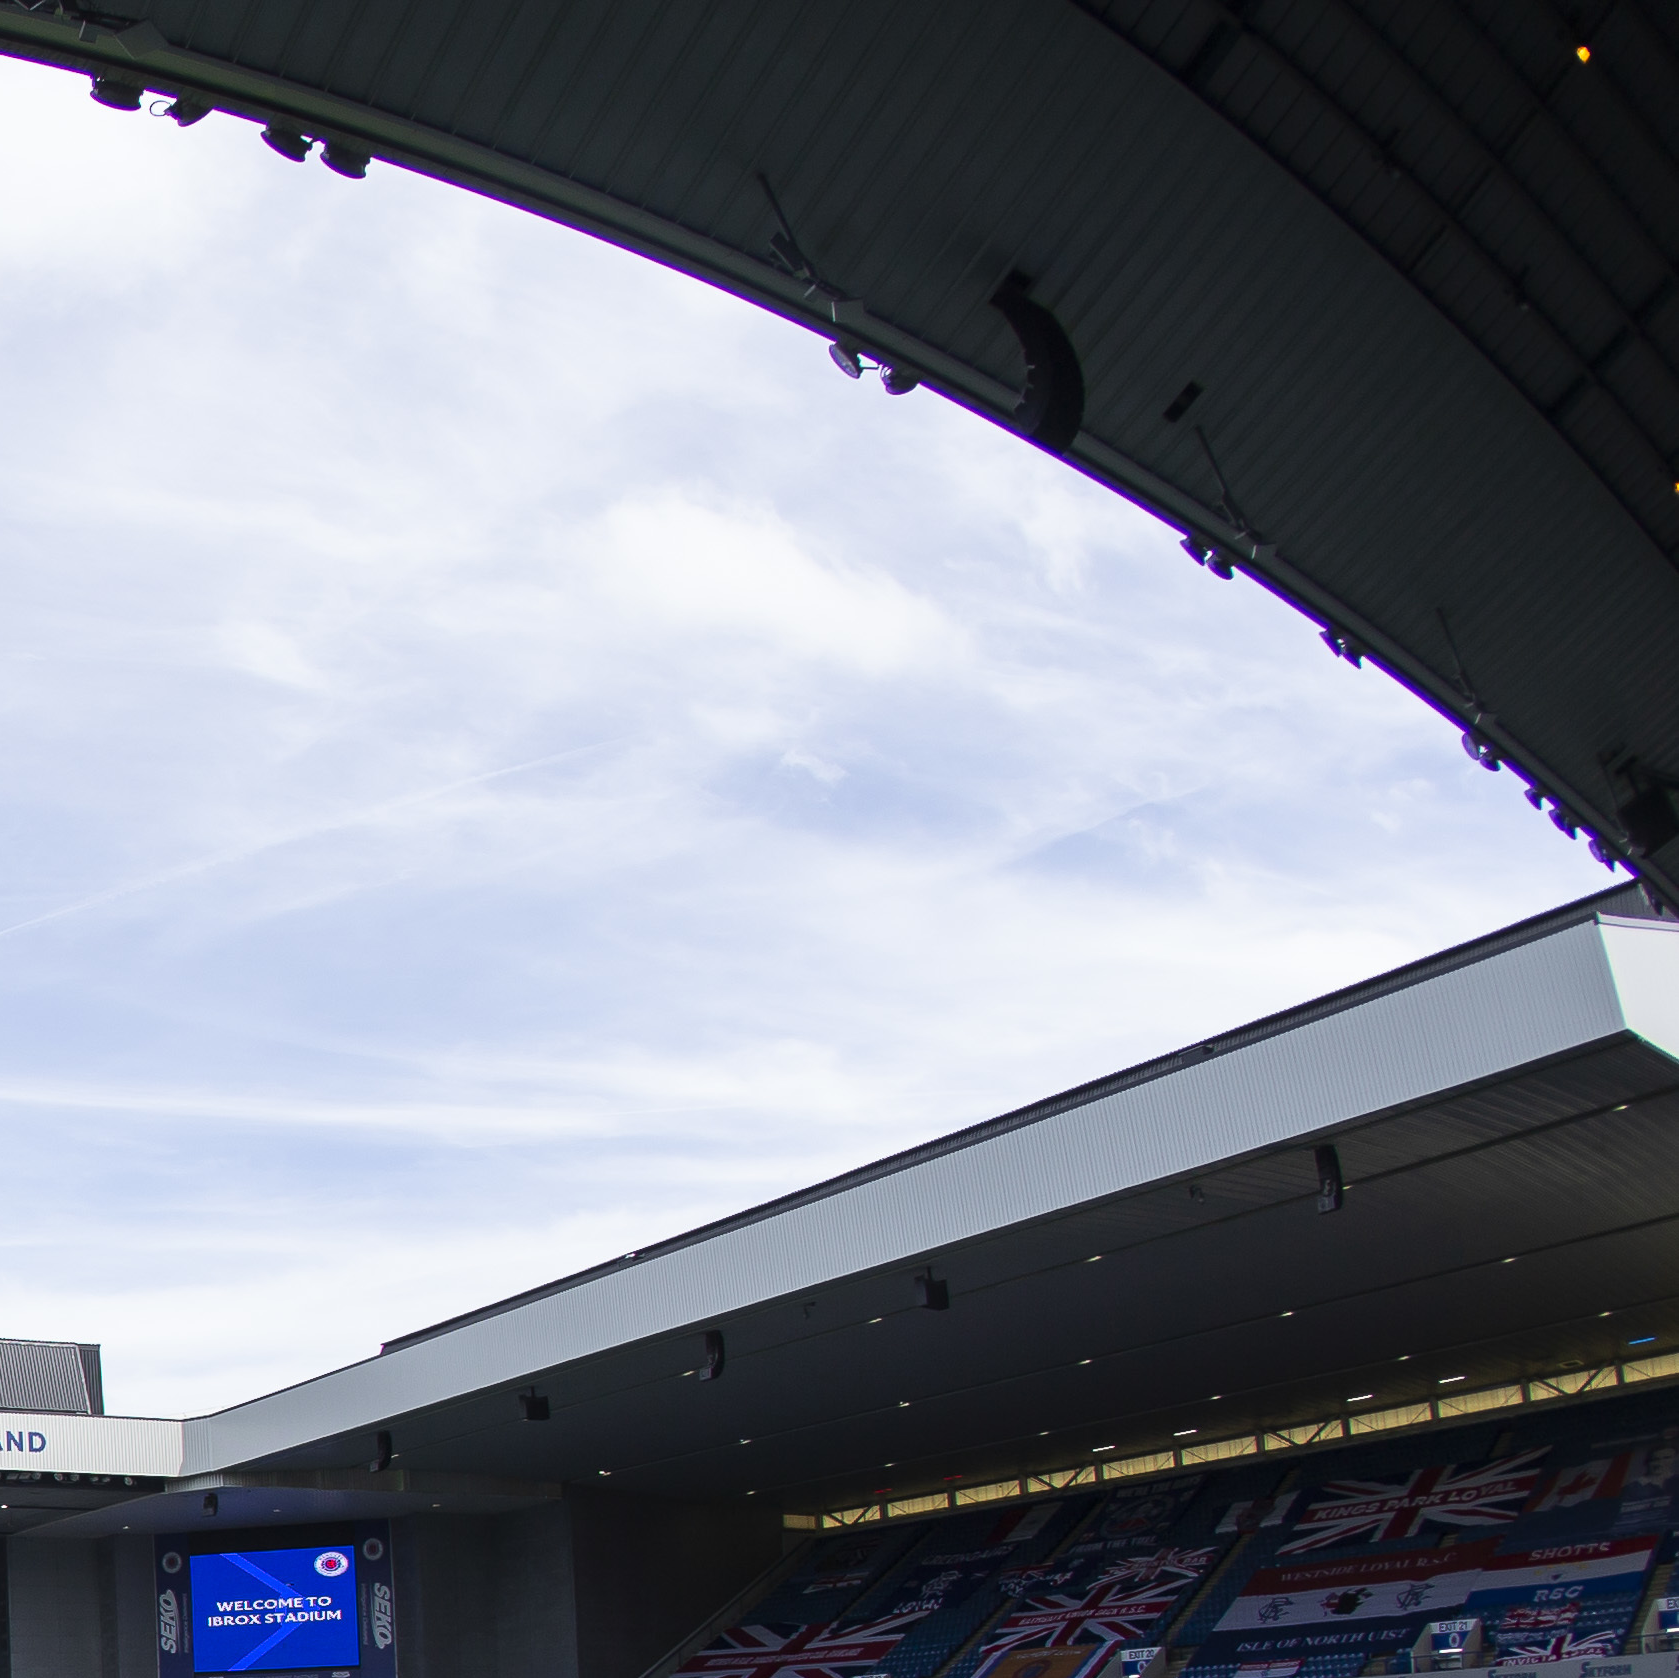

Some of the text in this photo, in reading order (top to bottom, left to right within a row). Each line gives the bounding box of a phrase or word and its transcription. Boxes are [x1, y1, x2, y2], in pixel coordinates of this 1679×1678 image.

[216, 1595, 332, 1613] WELCOME TO
[207, 1609, 342, 1627] IBROX STADIUM
